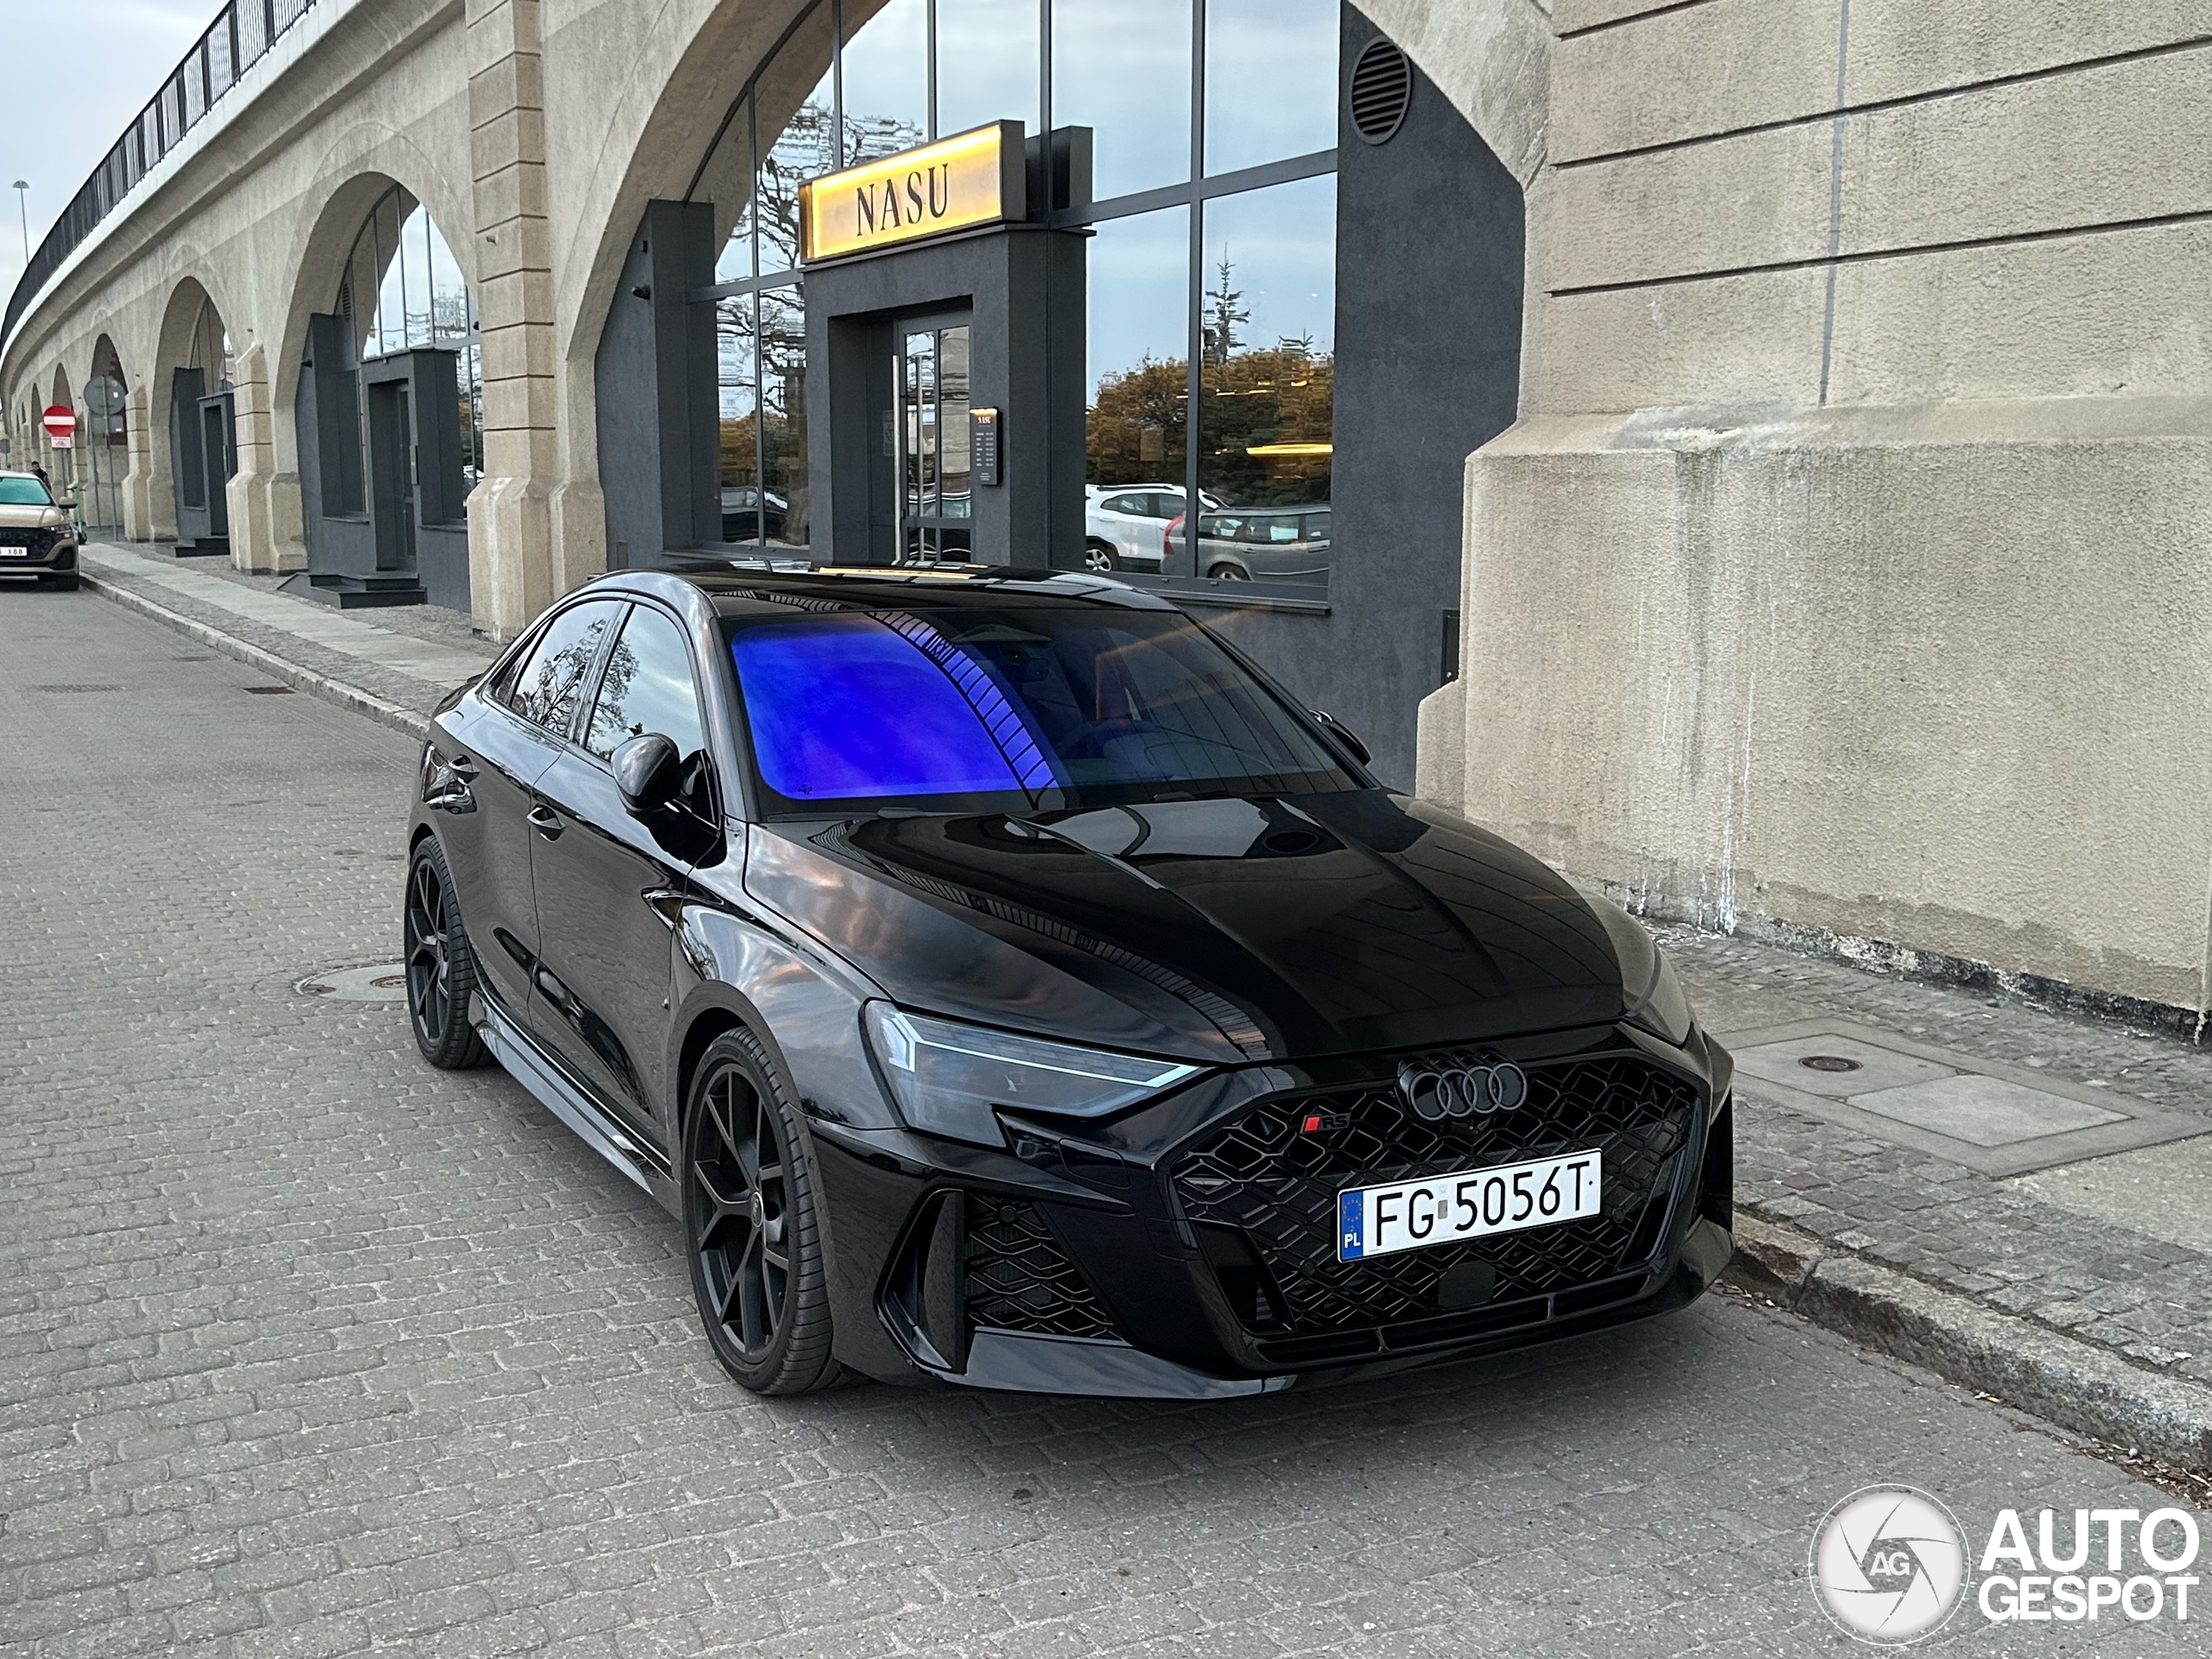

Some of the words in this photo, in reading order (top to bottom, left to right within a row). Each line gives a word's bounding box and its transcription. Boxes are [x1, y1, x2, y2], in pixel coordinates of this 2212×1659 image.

[855, 163, 949, 238] NASU
[1322, 1115, 1348, 1128] RS
[1376, 1188, 1434, 1246] FG
[1454, 1160, 1590, 1231] 5056T
[1344, 1232, 1361, 1249] PL
